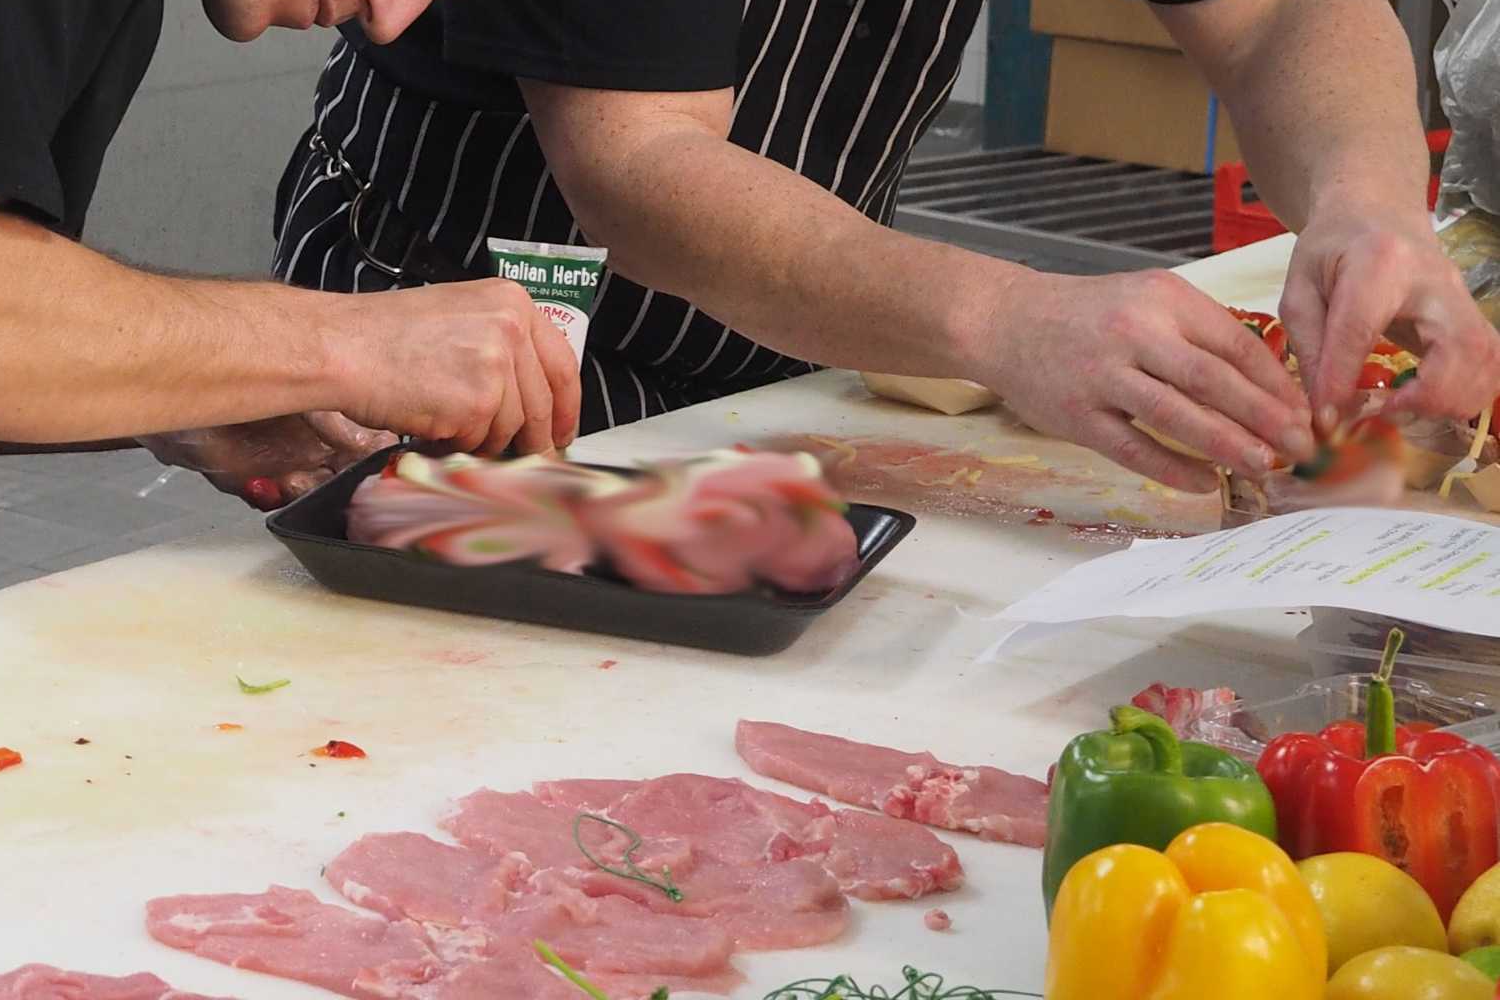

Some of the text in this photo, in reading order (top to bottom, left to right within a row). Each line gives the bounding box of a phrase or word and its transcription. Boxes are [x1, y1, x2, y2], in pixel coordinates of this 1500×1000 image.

[498, 258, 599, 287] Italian Herbs
[551, 289, 580, 298] PASTE
[540, 306, 575, 324] RMET
